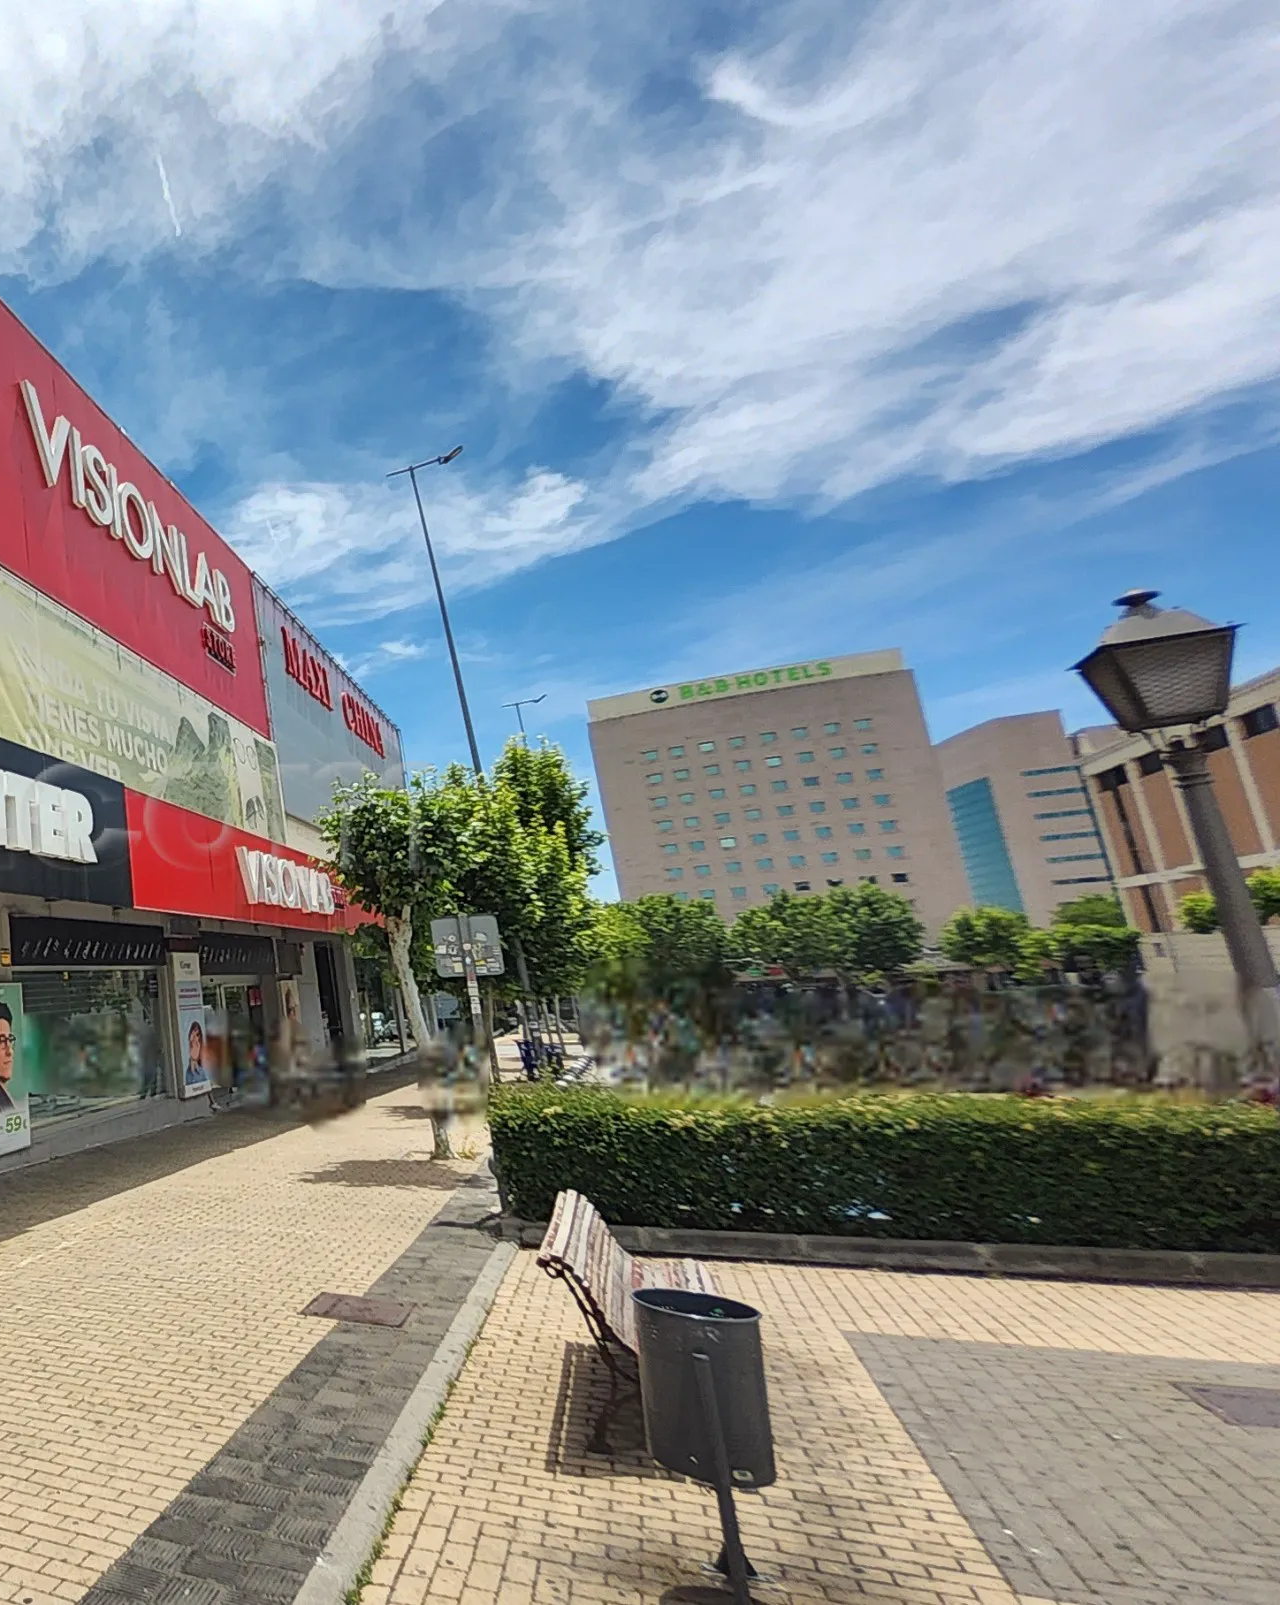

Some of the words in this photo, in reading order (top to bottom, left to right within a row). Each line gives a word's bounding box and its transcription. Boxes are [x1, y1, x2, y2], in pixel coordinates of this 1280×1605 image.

[21, 379, 236, 633] VISIONLAB
[93, 679, 119, 717] TU
[678, 679, 730, 700] B&B
[734, 661, 833, 690] HOTELS
[104, 721, 168, 774] MUCHO
[235, 846, 335, 915] VISIONLAB
